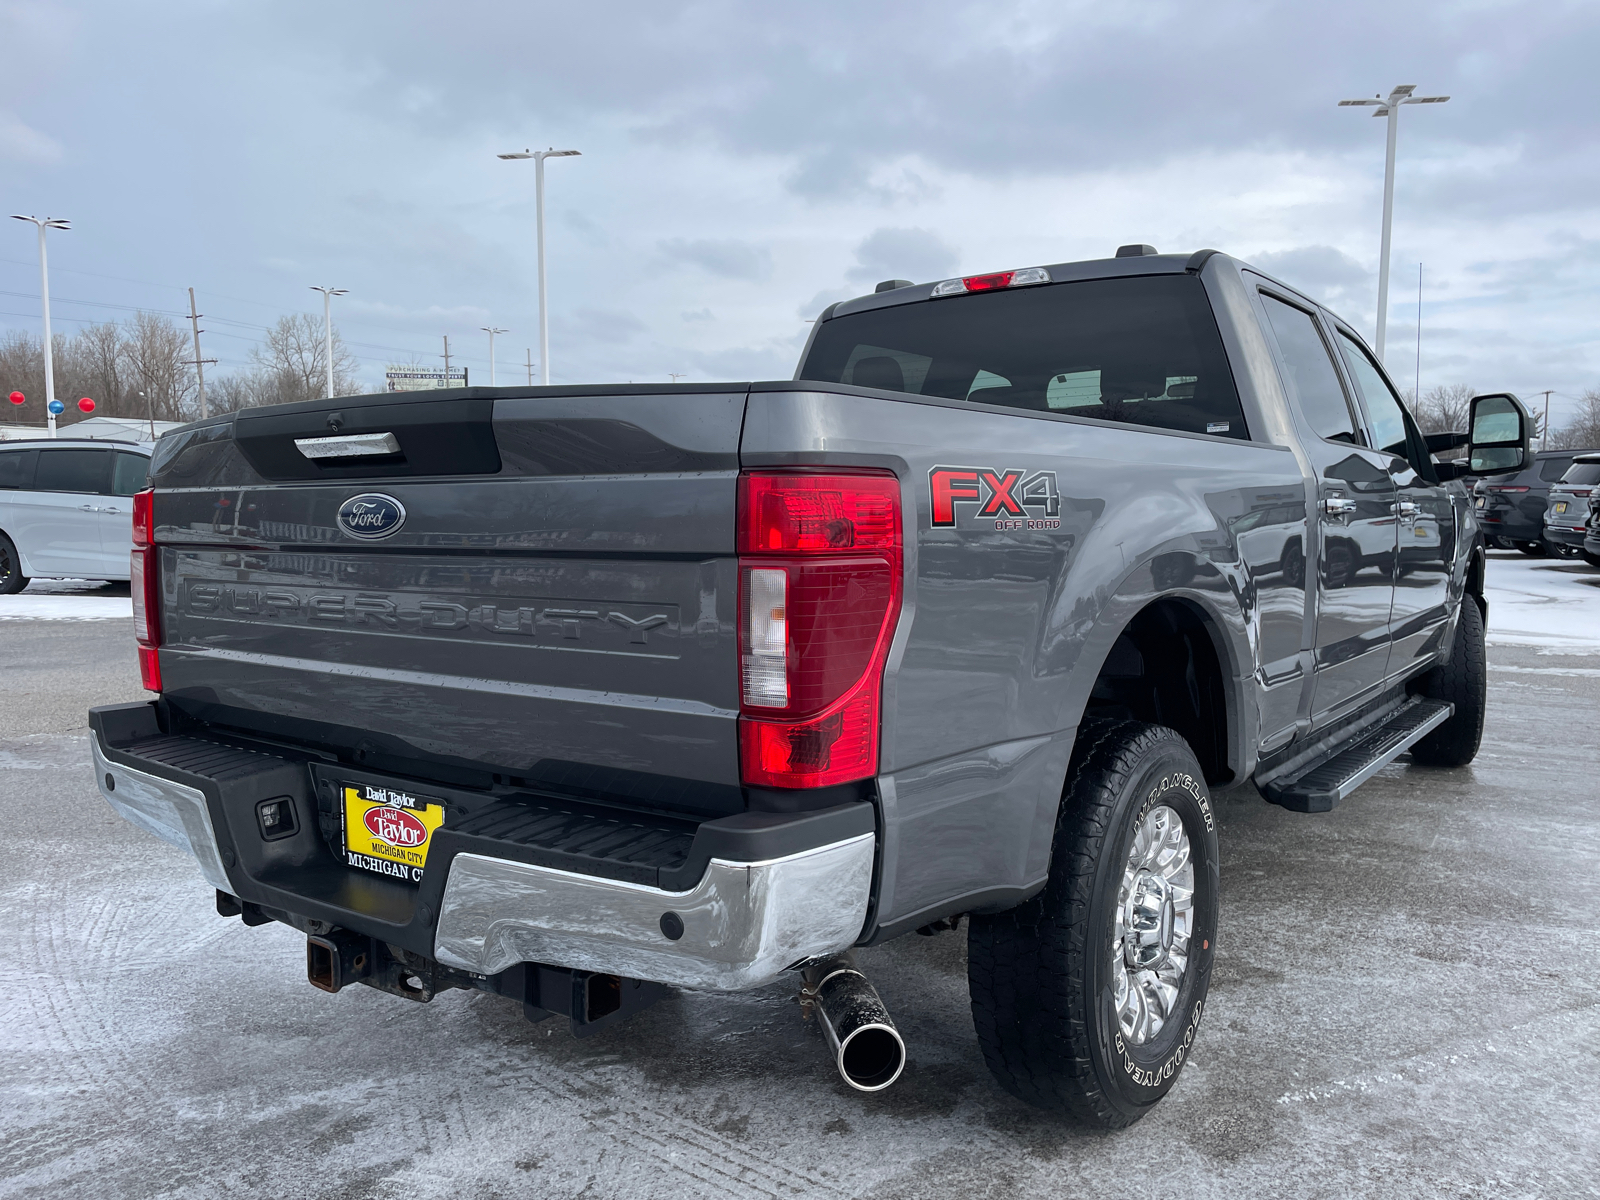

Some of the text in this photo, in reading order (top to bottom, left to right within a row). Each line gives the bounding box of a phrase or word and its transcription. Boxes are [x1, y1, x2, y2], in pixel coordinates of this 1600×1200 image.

[928, 464, 1061, 529] FX4
[349, 502, 386, 527] Ford
[995, 519, 1061, 531] OFF ROAD
[189, 586, 669, 645] SUPER DUTY
[366, 786, 415, 809] David Taylor
[1133, 772, 1214, 833] WRANGLER
[372, 808, 421, 846] David Taylor
[347, 852, 409, 880] MICHIGAN
[371, 842, 423, 865] MICHIGAN CITY
[1114, 1000, 1202, 1087] GOODYEAR
